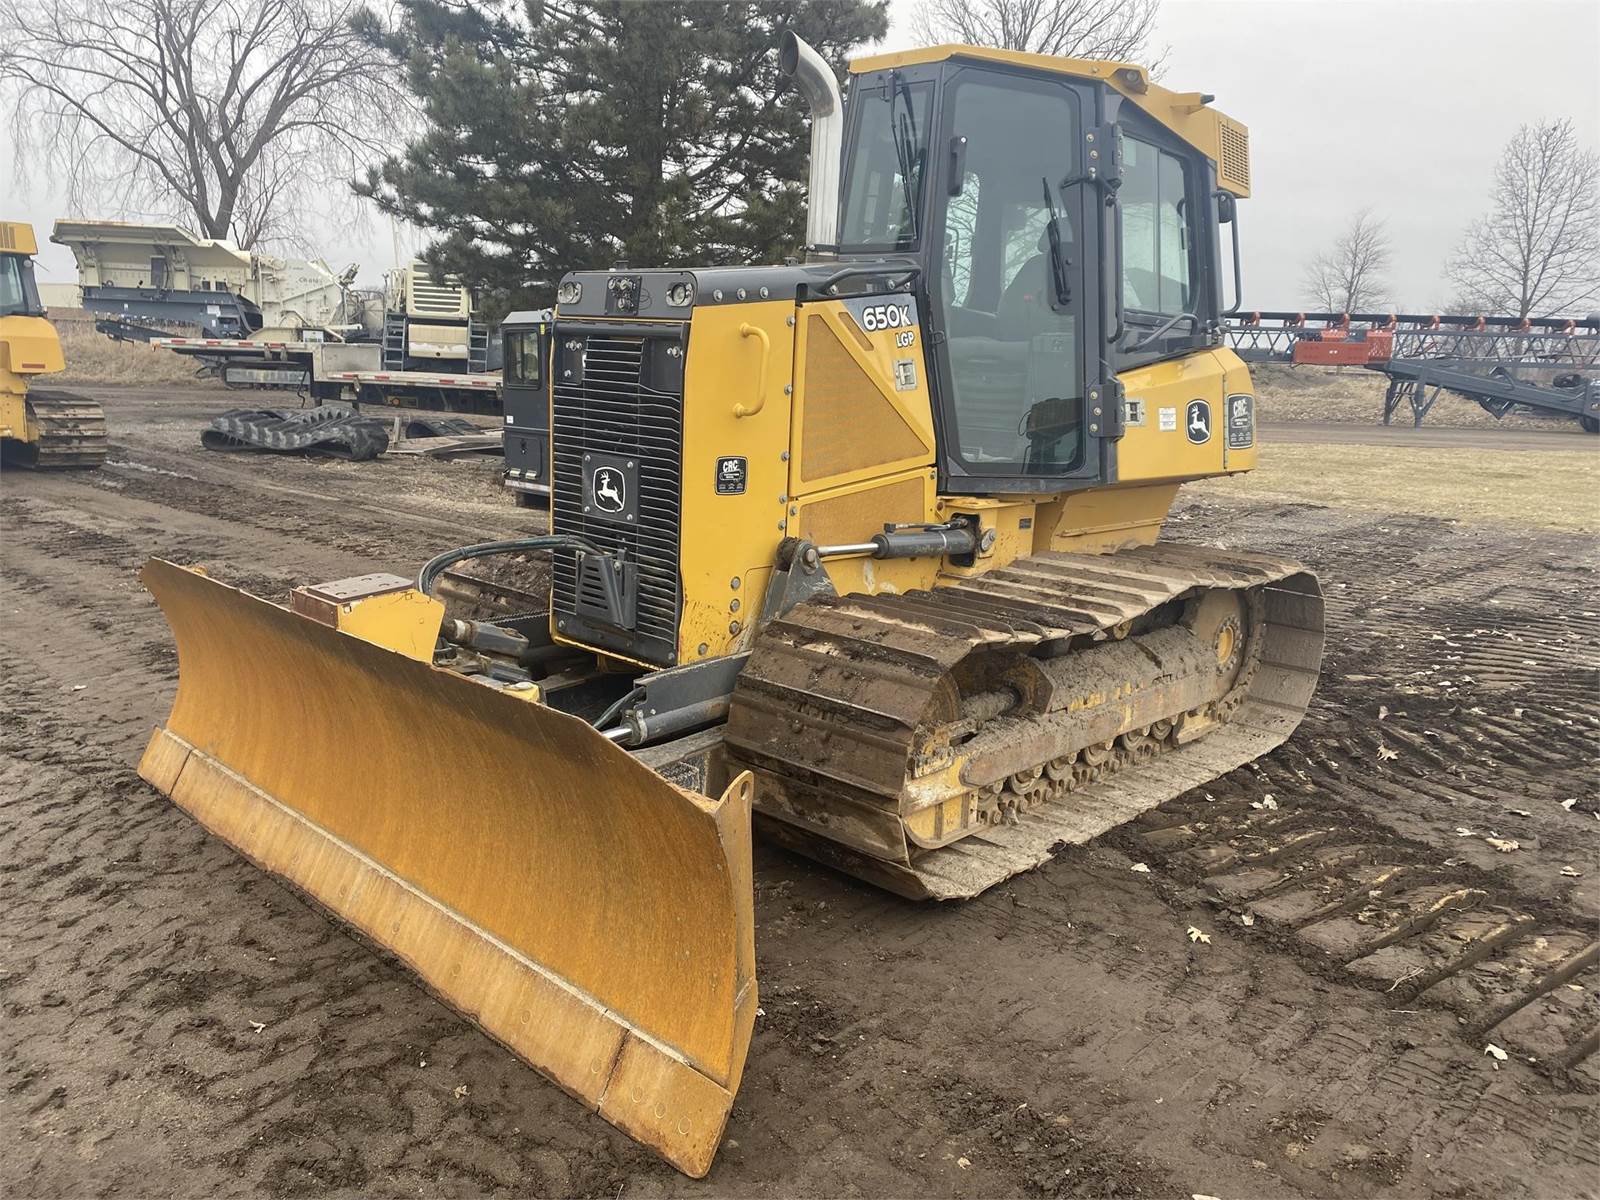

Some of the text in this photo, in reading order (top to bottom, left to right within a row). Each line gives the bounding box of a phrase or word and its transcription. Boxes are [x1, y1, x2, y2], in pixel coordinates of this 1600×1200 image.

[863, 304, 912, 331] 650K
[895, 331, 914, 347] LGP
[723, 459, 740, 472] CRC
